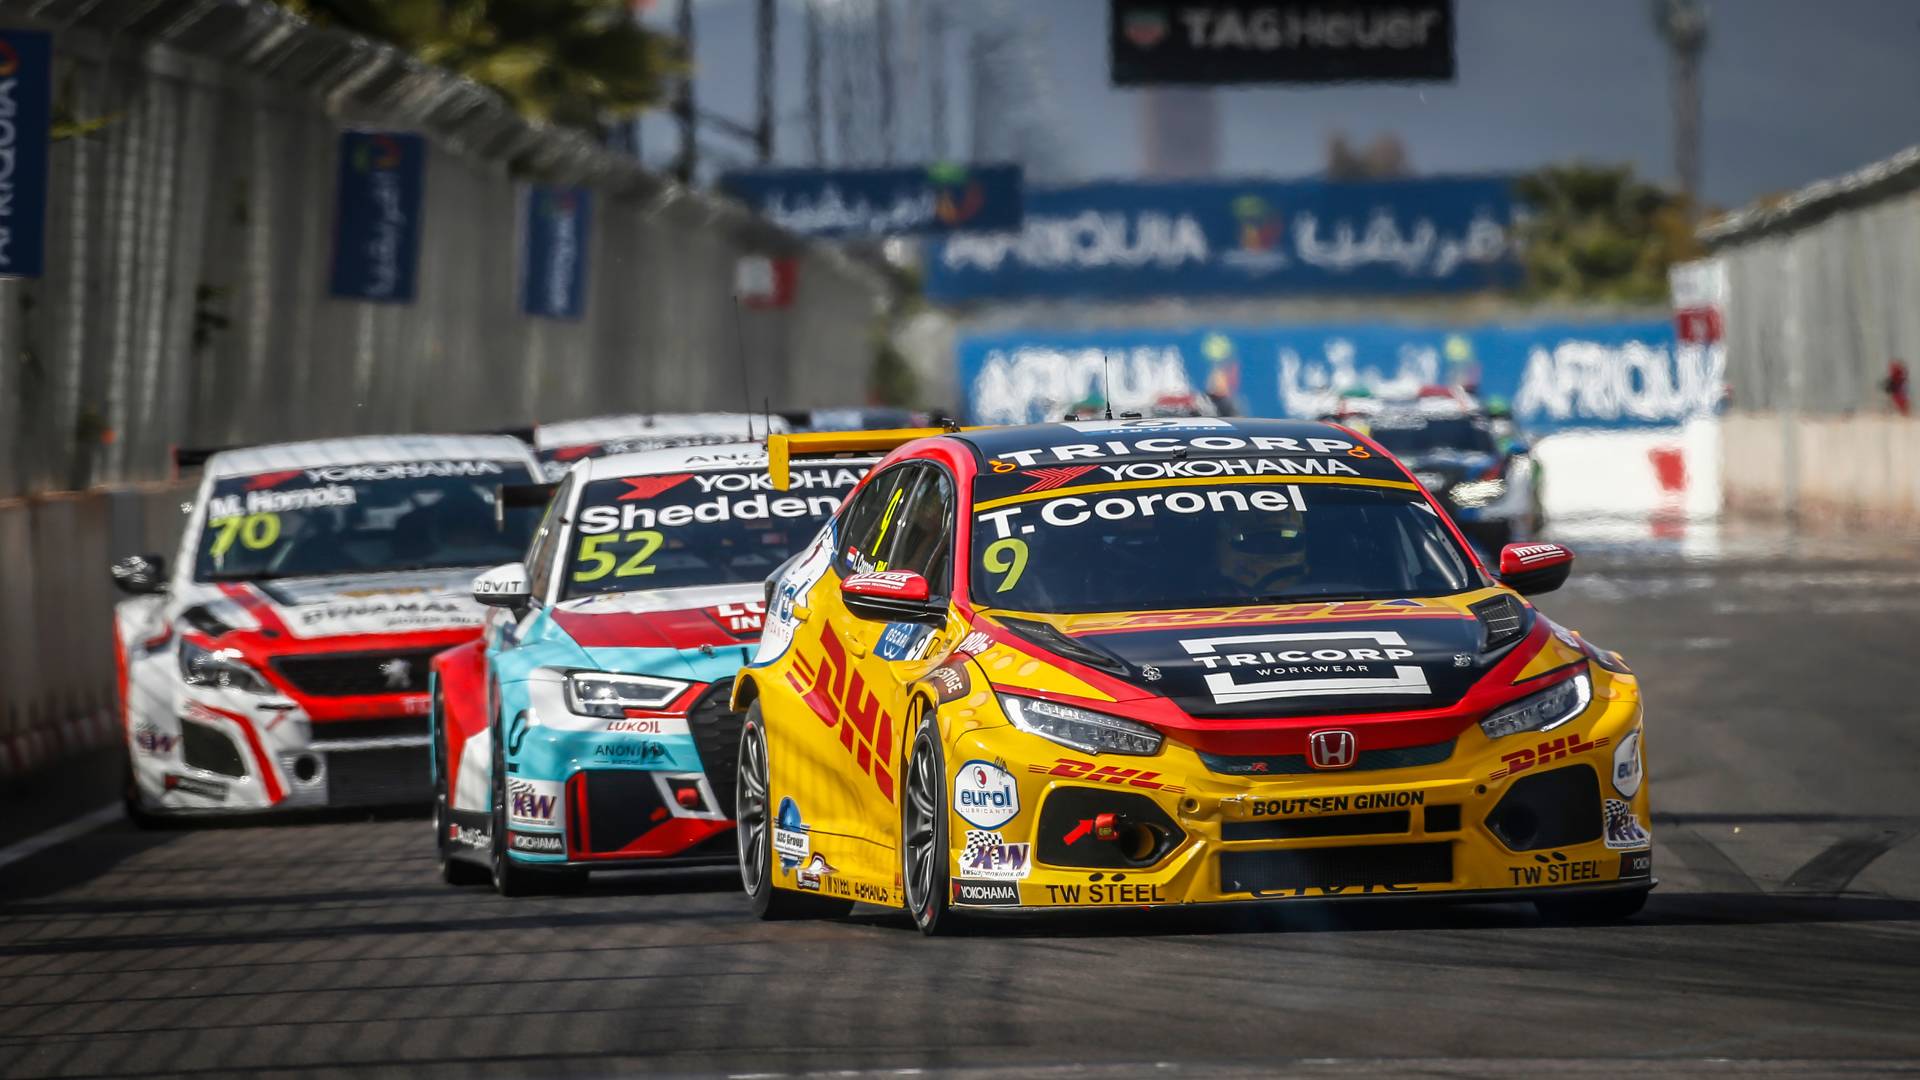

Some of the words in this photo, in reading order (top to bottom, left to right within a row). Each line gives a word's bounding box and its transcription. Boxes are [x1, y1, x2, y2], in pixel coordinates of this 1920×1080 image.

[998, 436, 1354, 467] TRICORP
[305, 460, 503, 483] YOKOHAMA
[1101, 458, 1361, 482] YOKOHAMA
[578, 493, 842, 534] Shedden
[208, 511, 281, 558] 70
[573, 530, 665, 582] 52
[982, 538, 1031, 593] 9
[1192, 647, 1415, 668] TRICORP
[1256, 664, 1370, 677] WORKWEAR
[801, 617, 895, 806] DHL
[606, 720, 662, 734] LUKOIL
[1500, 733, 1595, 776] DHL
[1047, 757, 1165, 790] DHL
[960, 784, 1012, 808] eurol
[1252, 796, 1349, 817] BOUTSEN
[1353, 790, 1425, 810] GINION
[969, 844, 1030, 871] KW
[1508, 866, 1542, 886] TW
[1547, 860, 1600, 883] STEEL
[960, 884, 1017, 900] YOKOHAMA
[1045, 884, 1081, 904] TW
[1088, 883, 1166, 903] STEEL
